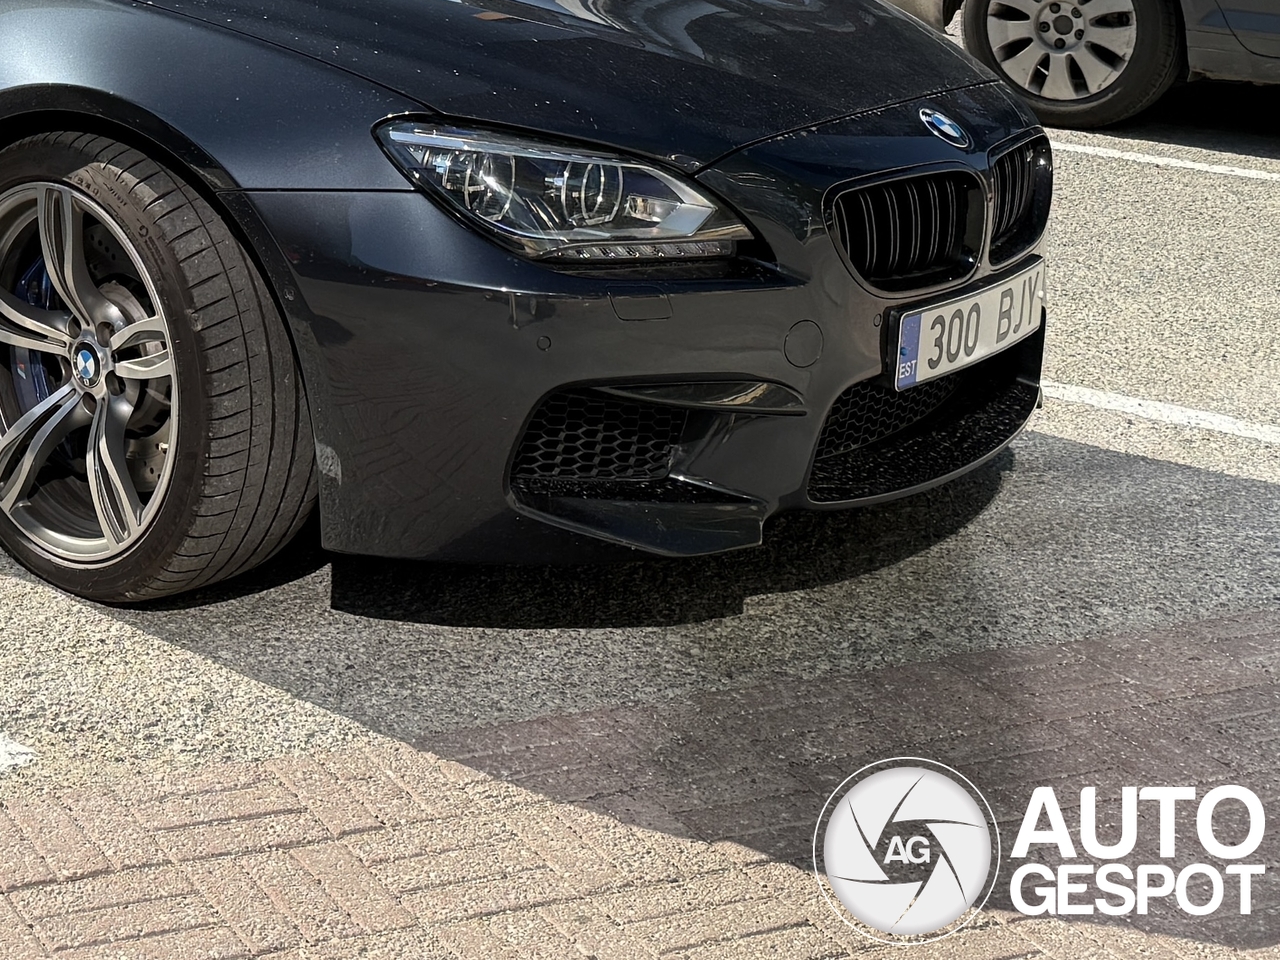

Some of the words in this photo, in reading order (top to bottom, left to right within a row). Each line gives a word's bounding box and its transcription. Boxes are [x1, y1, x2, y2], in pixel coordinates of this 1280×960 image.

[927, 302, 981, 370] 300
[995, 271, 1040, 345] BJY
[898, 359, 917, 379] EST
